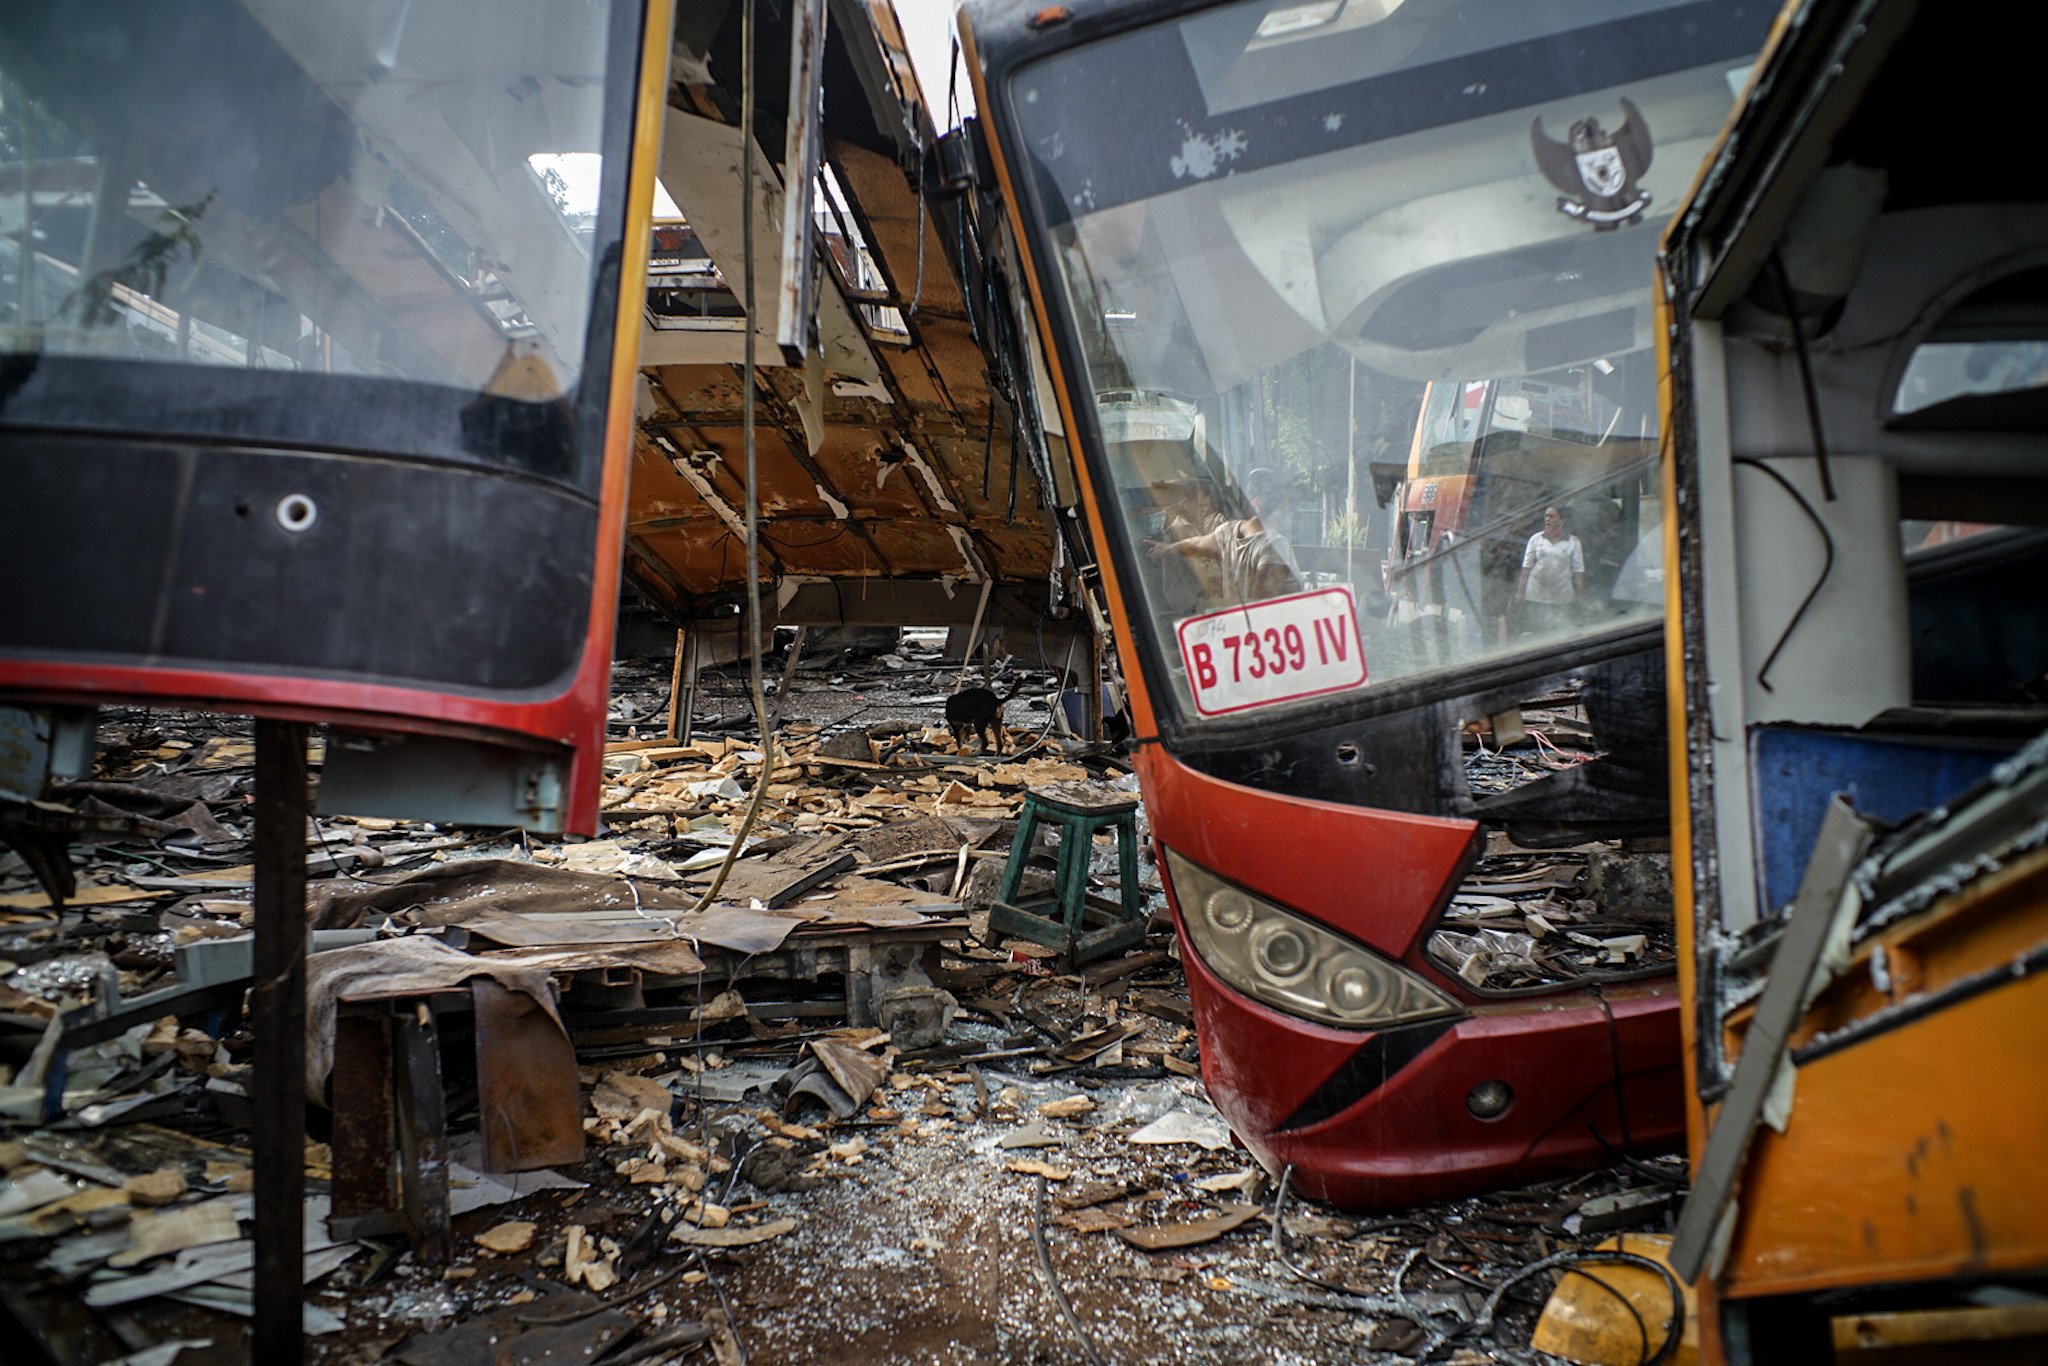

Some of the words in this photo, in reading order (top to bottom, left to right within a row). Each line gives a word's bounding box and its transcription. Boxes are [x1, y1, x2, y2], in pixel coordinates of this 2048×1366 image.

[1192, 643, 1217, 690] B
[1223, 624, 1305, 683] 7339
[1313, 615, 1347, 666] IV
